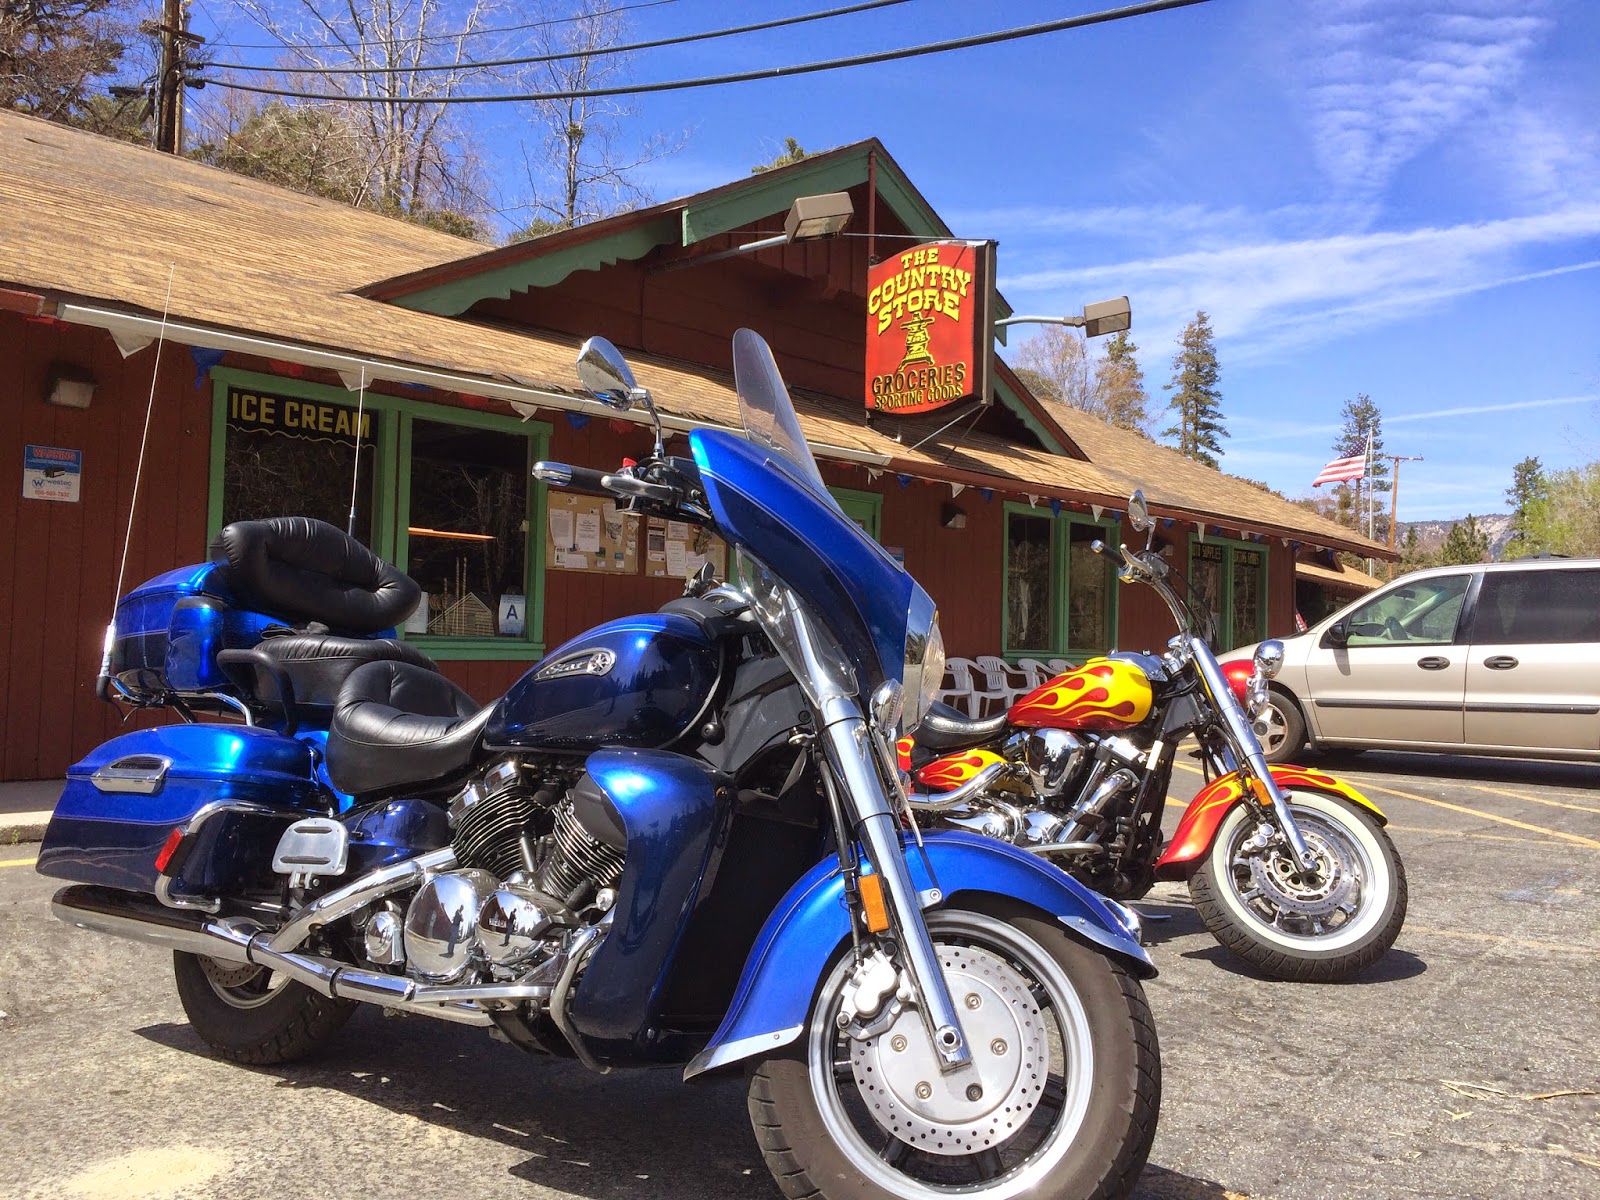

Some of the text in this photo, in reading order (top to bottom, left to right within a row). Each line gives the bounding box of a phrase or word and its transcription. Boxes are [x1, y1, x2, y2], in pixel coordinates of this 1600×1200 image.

[901, 248, 939, 269] THE
[868, 265, 972, 315] COUNTRY
[878, 289, 960, 335] STORE
[872, 362, 966, 395] GROCERIES
[875, 383, 963, 410] SPORTING GOODS
[232, 392, 371, 439] ICE CREAM
[33, 448, 77, 461] WARNING
[506, 604, 518, 620] A
